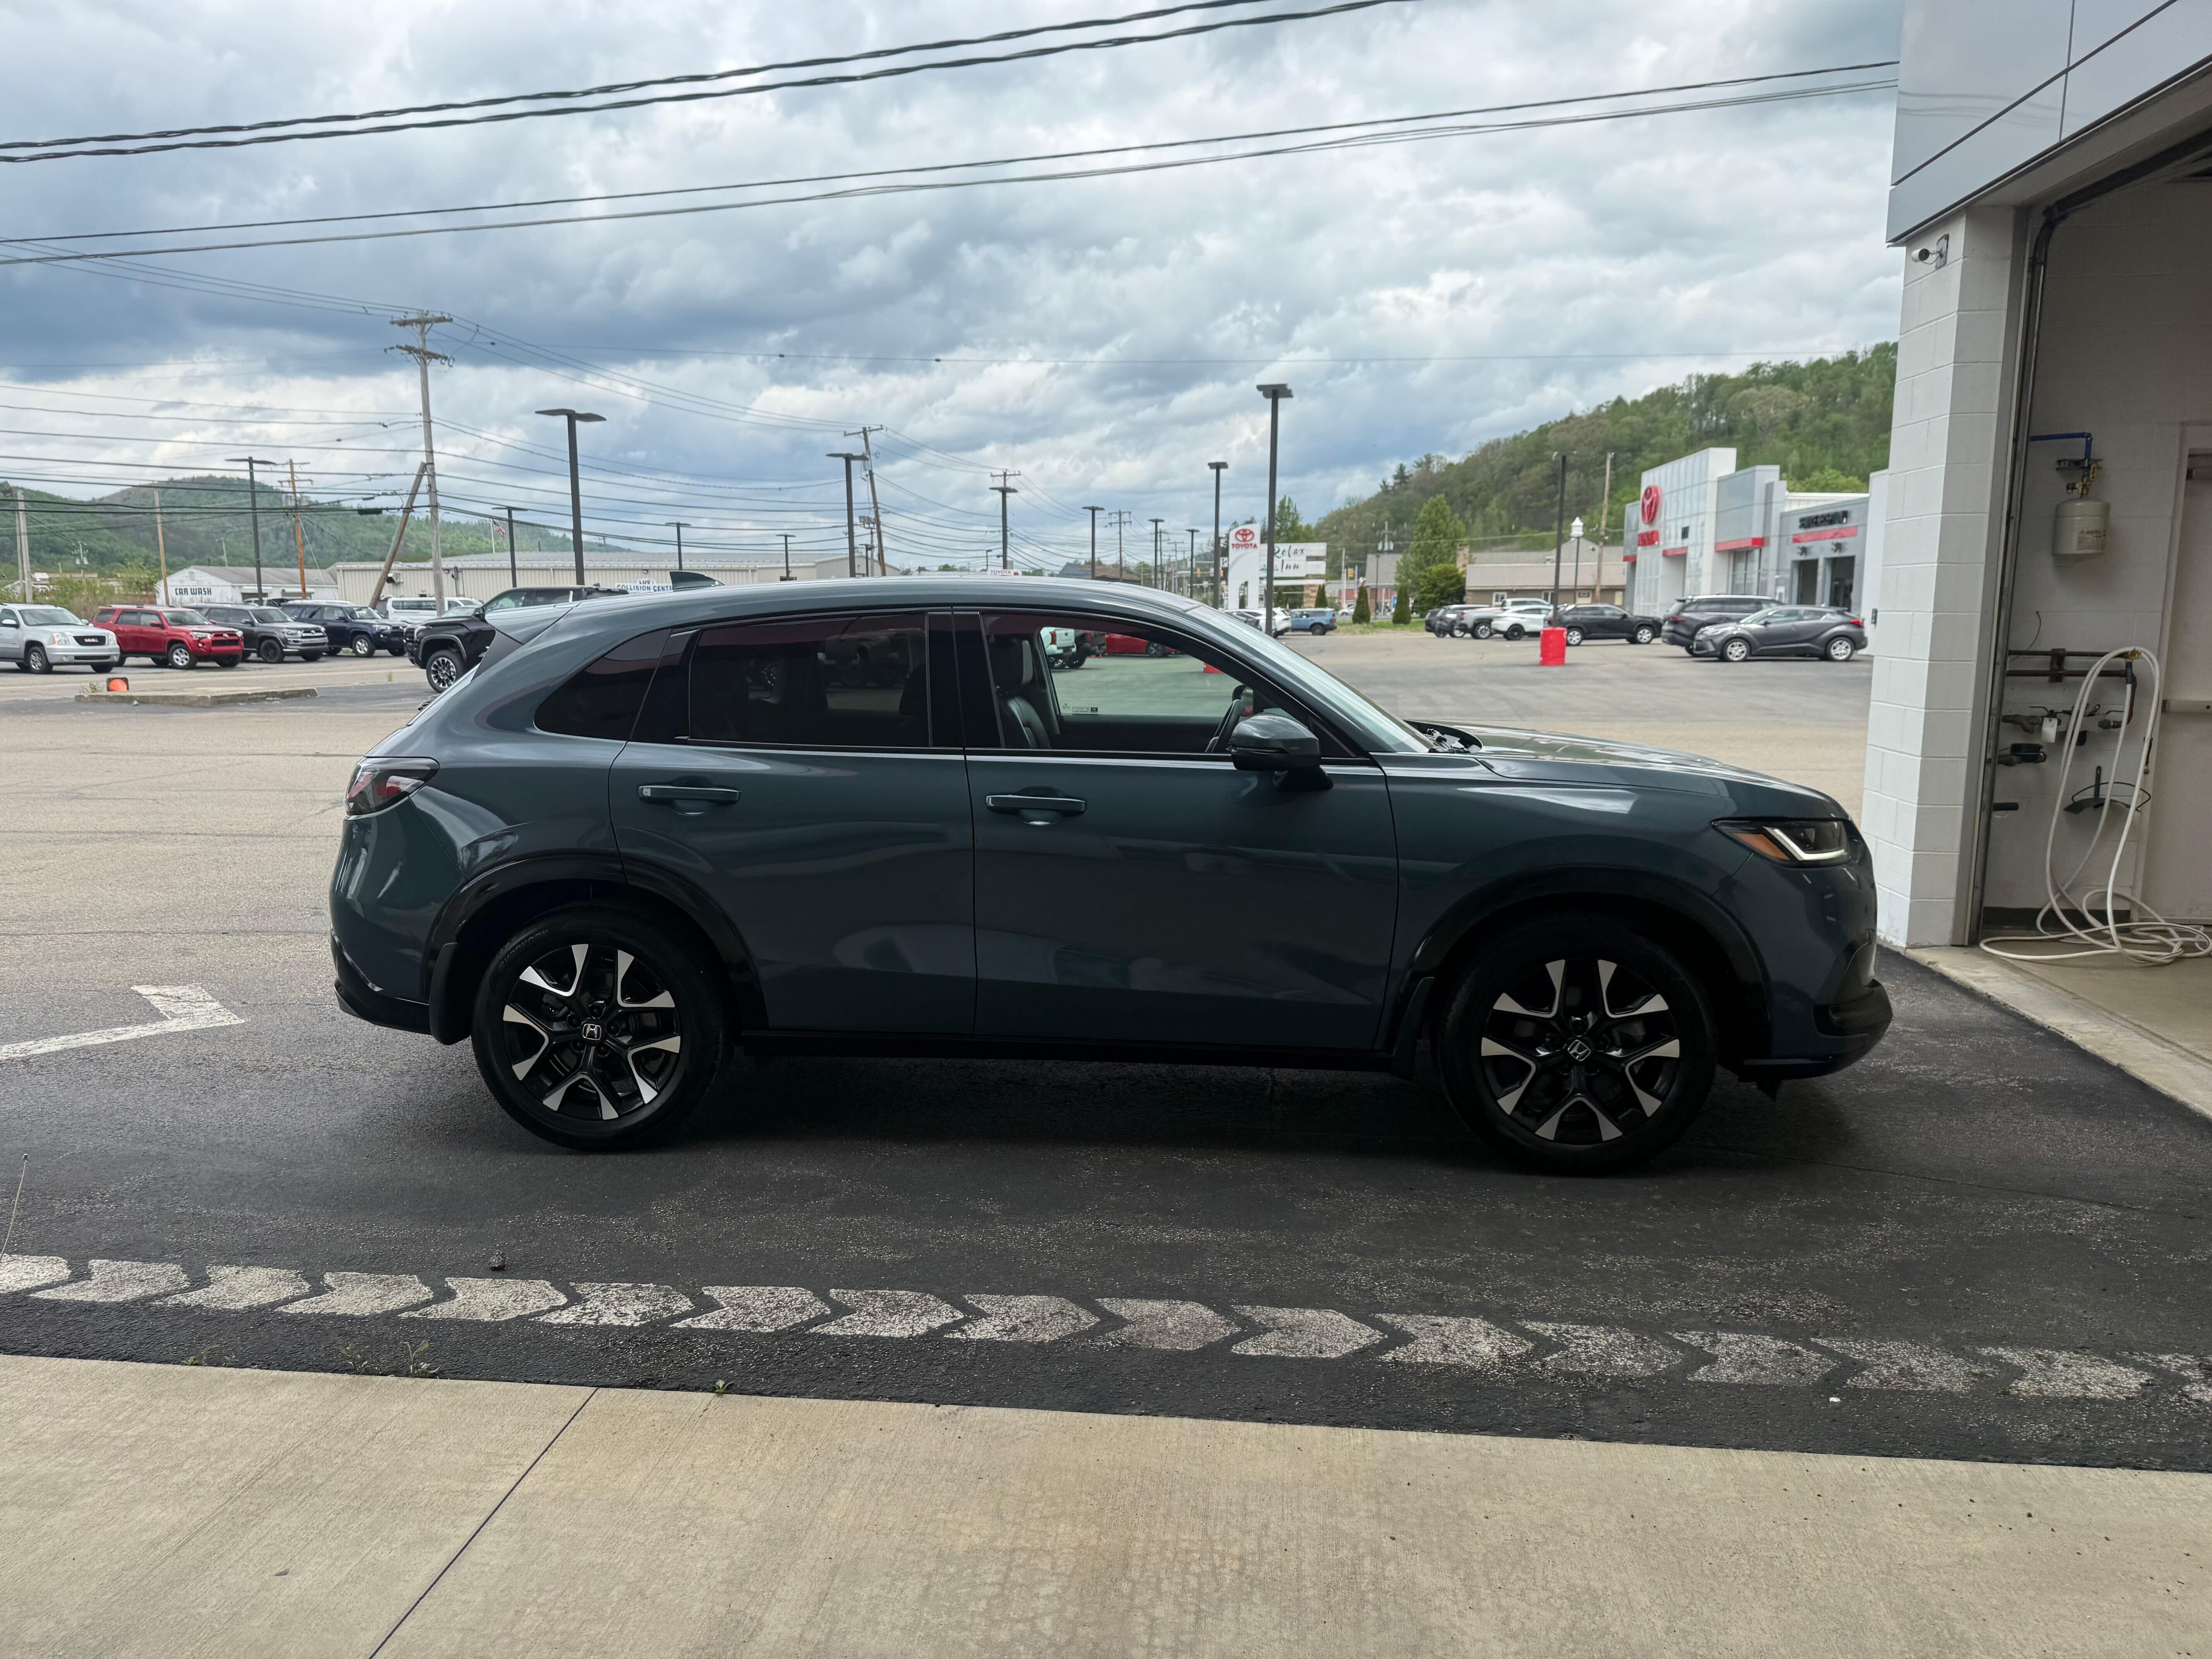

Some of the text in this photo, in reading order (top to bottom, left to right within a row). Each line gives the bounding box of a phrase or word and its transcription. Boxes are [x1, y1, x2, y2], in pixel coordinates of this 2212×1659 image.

[1281, 559, 1300, 573] Inn
[175, 587, 212, 596] CAR WASH
